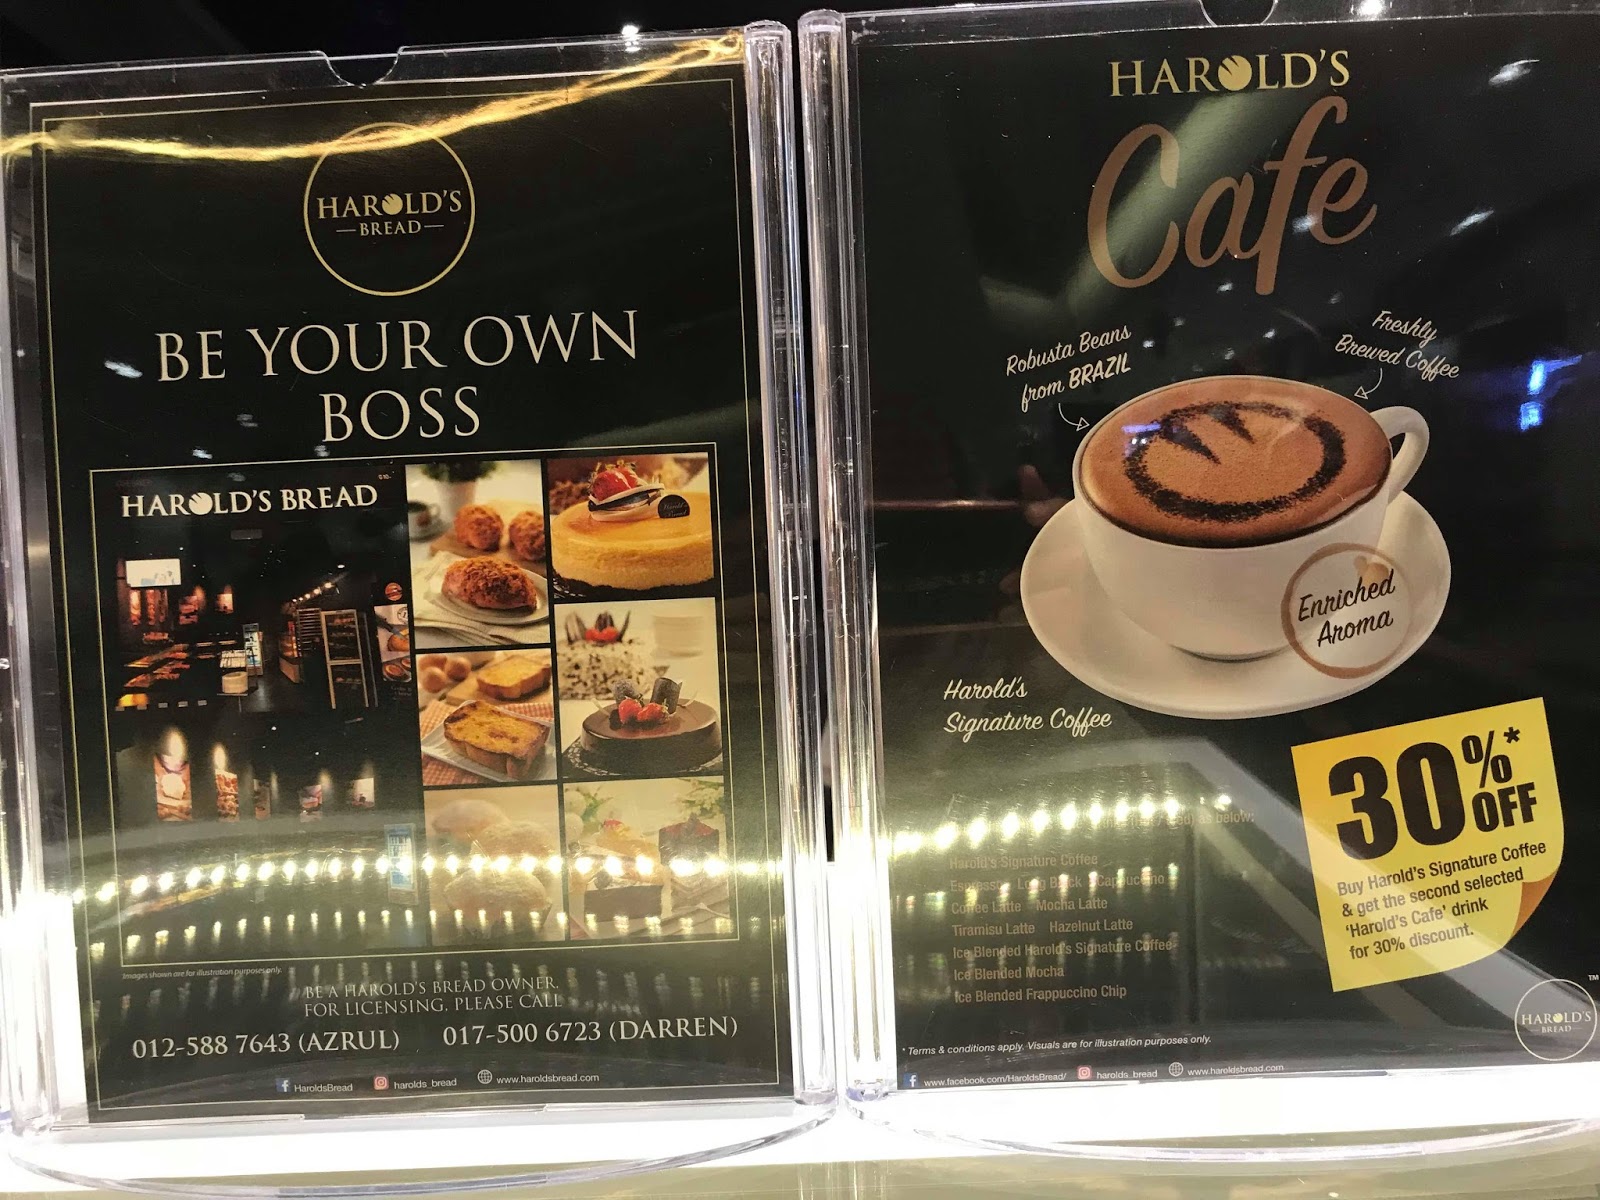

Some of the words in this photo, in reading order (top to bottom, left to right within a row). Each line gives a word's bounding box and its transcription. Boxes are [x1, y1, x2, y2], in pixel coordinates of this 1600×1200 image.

[1108, 49, 1350, 97] HAROLD'S
[317, 190, 462, 219] HAROLD'S
[1087, 95, 1378, 296] Cafe
[360, 221, 421, 236] BREAD
[1372, 310, 1438, 348] Freshly
[155, 330, 226, 382] BE
[246, 320, 448, 377] YOUR
[464, 310, 638, 367] OWN
[1006, 342, 1075, 377] Robusta
[1079, 325, 1131, 353] Beans
[1335, 334, 1405, 365] Brewed
[1406, 350, 1460, 382] Coffee
[1021, 379, 1065, 413] from
[1068, 352, 1131, 390] BRAZIL
[319, 386, 480, 443] BOSS
[122, 490, 272, 517] HAROLD'S
[281, 484, 378, 510] BREAD
[1298, 568, 1396, 622] Enriched
[1317, 609, 1394, 647] Aroma
[943, 676, 1028, 700] Harold's
[943, 711, 1044, 743] Signature
[1049, 707, 1112, 737] Coffee
[1216, 809, 1255, 824] below:
[1471, 782, 1538, 833] OFF
[950, 857, 997, 870] Harold's
[1001, 855, 1057, 870] Signature
[1060, 853, 1099, 867] Coffee
[1337, 881, 1363, 897] Buy
[1368, 866, 1426, 891] Harold's
[1429, 852, 1497, 878] Signature
[1501, 842, 1547, 862] Coffee
[1017, 878, 1046, 891] Log
[1050, 876, 1082, 889] Bck
[1097, 874, 1165, 889] Capucno
[1342, 903, 1353, 917] &
[1357, 899, 1379, 917] get
[1382, 892, 1406, 908] the
[1410, 880, 1461, 903] second
[1465, 867, 1524, 891] selected
[952, 902, 988, 914] Coffee
[993, 901, 1021, 912] Latte
[1036, 899, 1075, 911] Mocha
[1079, 898, 1108, 910] Latte
[1452, 897, 1488, 917] drink
[952, 923, 1003, 936] Tiramisu
[1006, 922, 1035, 935] Latte
[1050, 920, 1100, 933] Hazelnut
[1104, 918, 1134, 931] Latte
[953, 947, 971, 959] Ice
[974, 945, 1020, 957] Blended
[1025, 943, 1072, 956] Harold's
[1075, 941, 1132, 956] Signature
[1135, 939, 1173, 952] Coffee
[1349, 945, 1370, 960] for
[1373, 937, 1405, 955] 30%
[1409, 922, 1474, 948] discount.
[123, 972, 149, 981] Images
[150, 970, 172, 979] shown
[185, 969, 195, 977] for
[197, 967, 233, 976] illustration
[234, 967, 265, 977] purposes
[266, 966, 282, 975] only.
[954, 969, 971, 981] Ice
[975, 967, 1021, 980] Blended
[1026, 966, 1065, 978] Mocha
[306, 986, 323, 999] BE
[328, 985, 339, 998] A
[345, 981, 426, 997] HAROLD'S
[433, 979, 486, 993] BREAD
[955, 990, 971, 1003] Ice
[976, 989, 1022, 1002] Blended
[1026, 987, 1097, 1003] Frappuccino
[1101, 985, 1127, 999] Chip
[304, 1002, 340, 1018] FOR
[454, 994, 513, 1011] PLEASE
[519, 993, 562, 1009] CALL
[1521, 1011, 1592, 1025] HAROLD'S
[1541, 1025, 1572, 1033] BREAD
[443, 1023, 538, 1046] 017-500
[545, 1020, 601, 1042] 6723
[609, 1016, 739, 1044] (DARREN)
[132, 1035, 228, 1059] 012-588
[235, 1032, 291, 1055] 7643
[299, 1029, 400, 1053] (AZRUL)
[908, 1046, 936, 1056] Terms
[938, 1045, 945, 1054] &
[947, 1043, 995, 1054] conditions
[997, 1042, 1024, 1054] apply.
[1027, 1040, 1060, 1051] Visuals
[1062, 1041, 1077, 1049] are
[1079, 1038, 1092, 1048] for
[1094, 1036, 1142, 1047] illustration
[1144, 1036, 1188, 1048] purposes
[1190, 1034, 1212, 1045] only.
[496, 1072, 600, 1085] www.haroldsbread.com
[924, 1072, 1067, 1087] www.facebook.com/HaroldsBread/
[1187, 1063, 1285, 1076] www.haroldsbread.com
[294, 1083, 353, 1093] HaroldsBread
